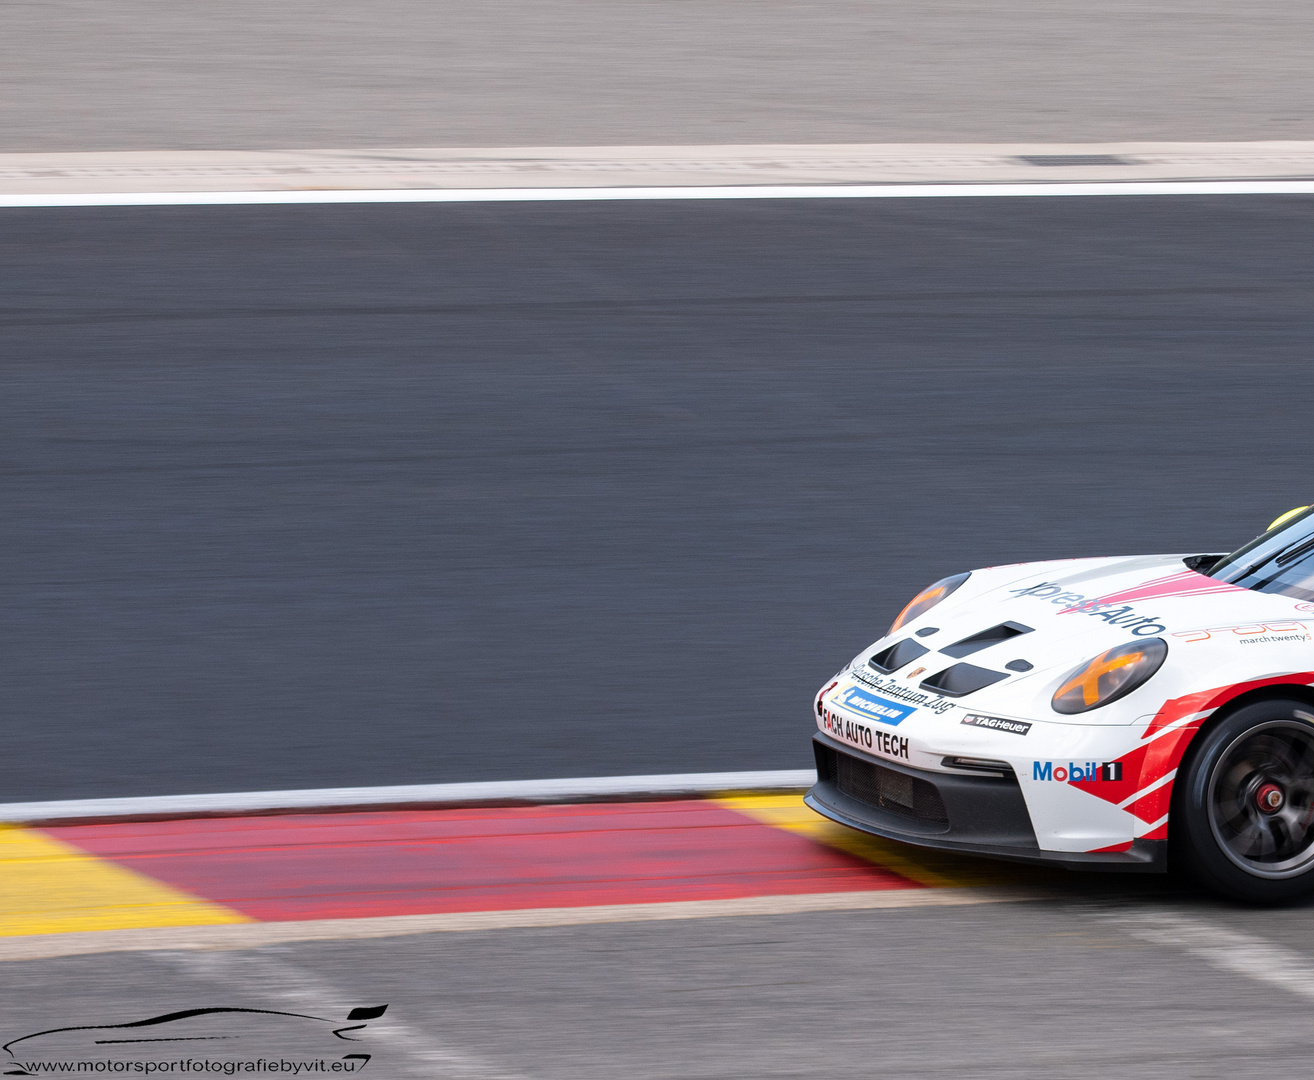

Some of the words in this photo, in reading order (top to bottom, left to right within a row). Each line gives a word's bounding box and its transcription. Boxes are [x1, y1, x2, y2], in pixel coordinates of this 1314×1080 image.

[847, 695, 904, 719] MICHELIN
[849, 663, 884, 690] Porsche
[877, 678, 930, 707] Zentrum
[922, 693, 958, 715] Zug
[823, 708, 844, 738] FACH
[846, 720, 873, 749] AUTO
[875, 730, 910, 760] TECH
[1033, 760, 1097, 783] Mobil
[1106, 762, 1118, 781] 1
